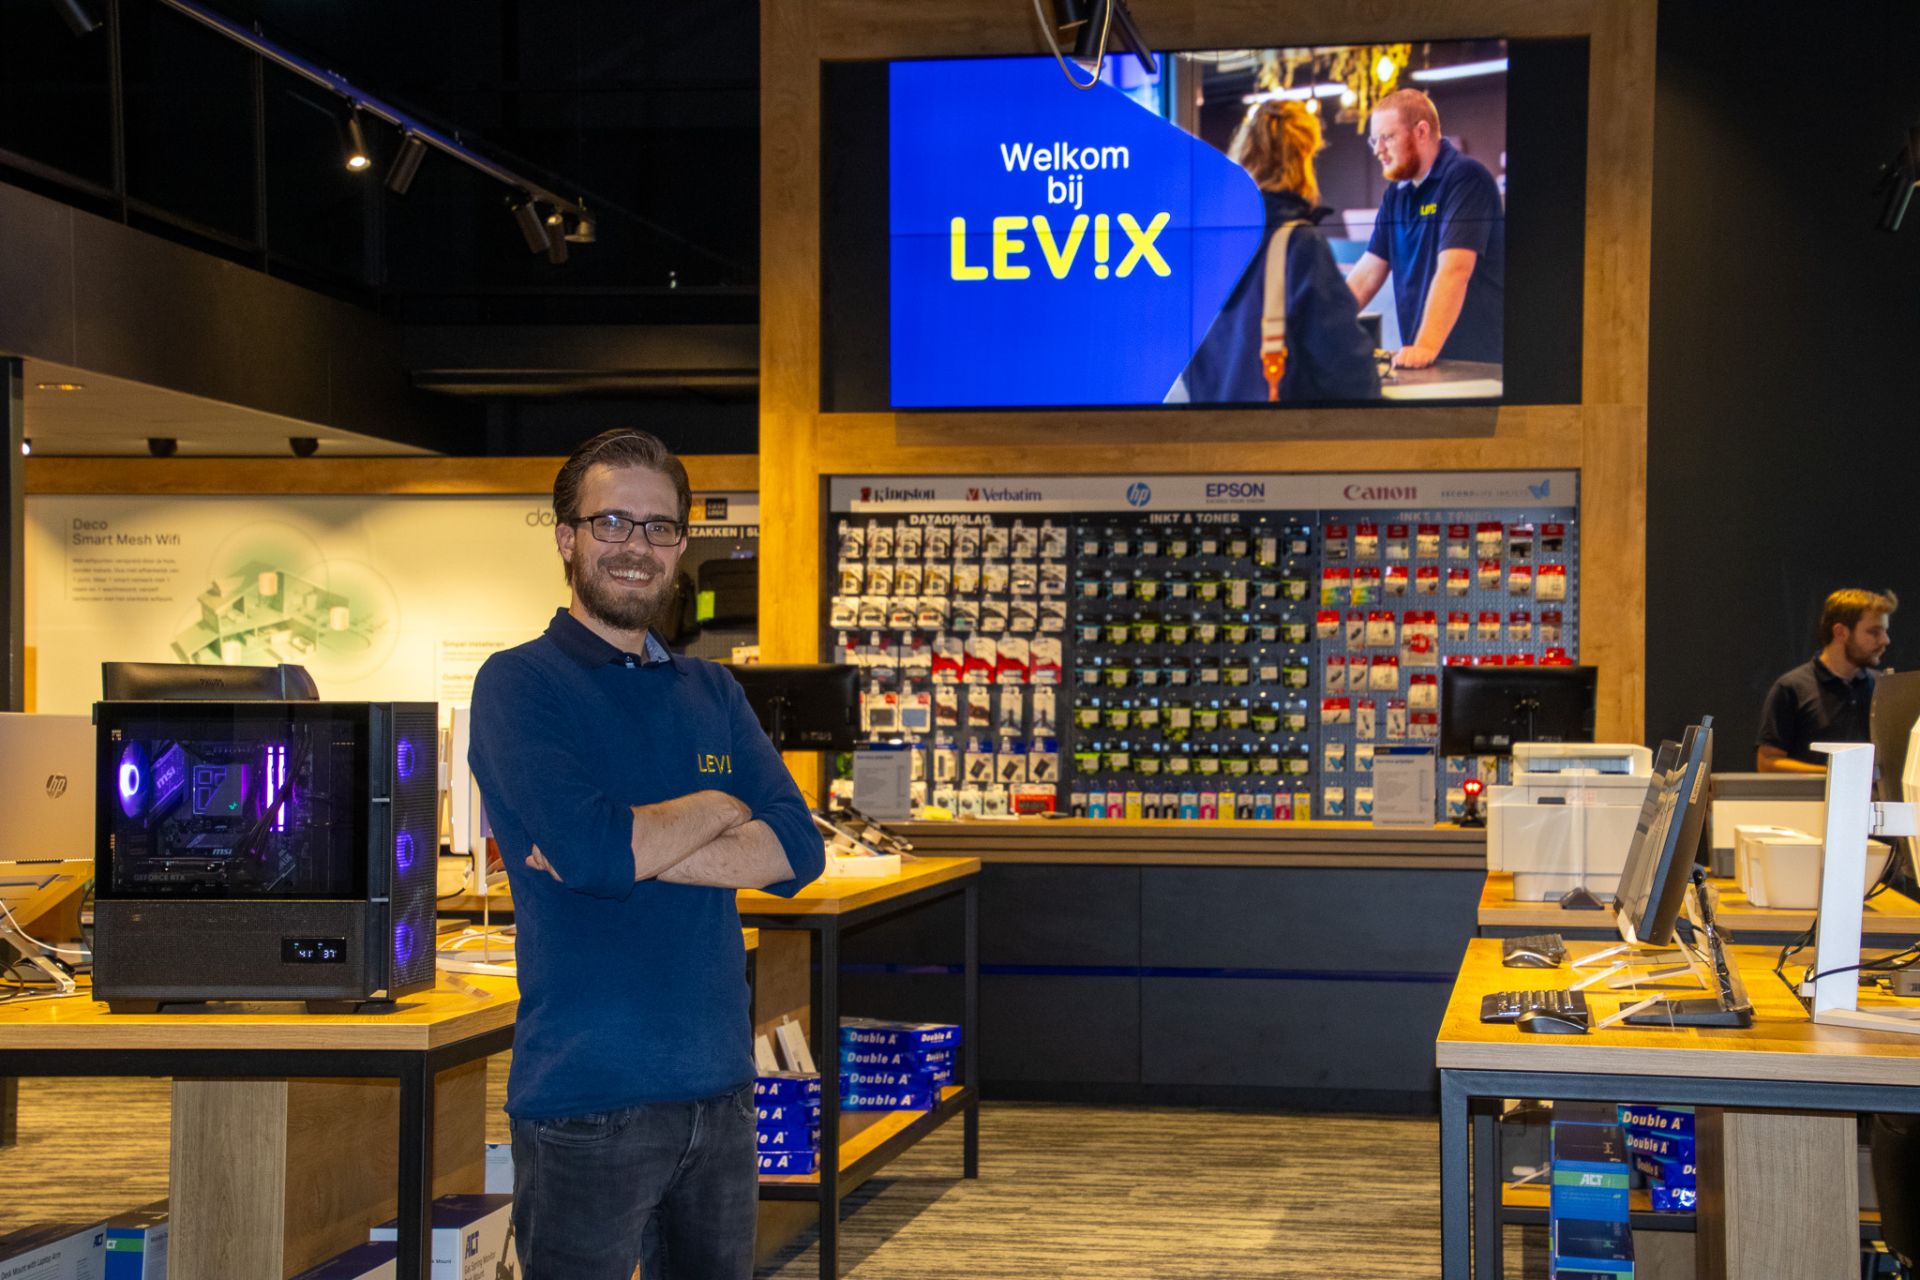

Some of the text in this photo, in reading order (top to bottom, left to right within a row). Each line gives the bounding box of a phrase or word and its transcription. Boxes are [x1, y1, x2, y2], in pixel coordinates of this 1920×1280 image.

[1000, 142, 1129, 172] Welkom
[1047, 174, 1084, 210] bij
[950, 212, 1172, 281] LEV!X
[875, 487, 935, 502] Kingston
[982, 488, 1042, 502] Verbatim
[1205, 483, 1266, 497] EPSON
[1343, 484, 1417, 501] Canon
[72, 518, 108, 530] Deco
[1196, 513, 1241, 524] TONER
[72, 533, 181, 545] Smart Mesh Wifi
[688, 527, 738, 538] ZAKKEN
[156, 766, 176, 789] msi
[46, 774, 68, 799] hp
[212, 848, 233, 856] msi
[850, 1031, 897, 1045] Double A
[921, 1031, 952, 1042] Double A
[847, 1052, 901, 1065] Double A
[850, 1073, 908, 1085] Double A
[849, 1094, 911, 1106] Double A
[1622, 1111, 1681, 1130] Double A
[1627, 1134, 1668, 1154] Double A
[1580, 1173, 1604, 1186] ACT
[464, 1230, 480, 1259] ACT
